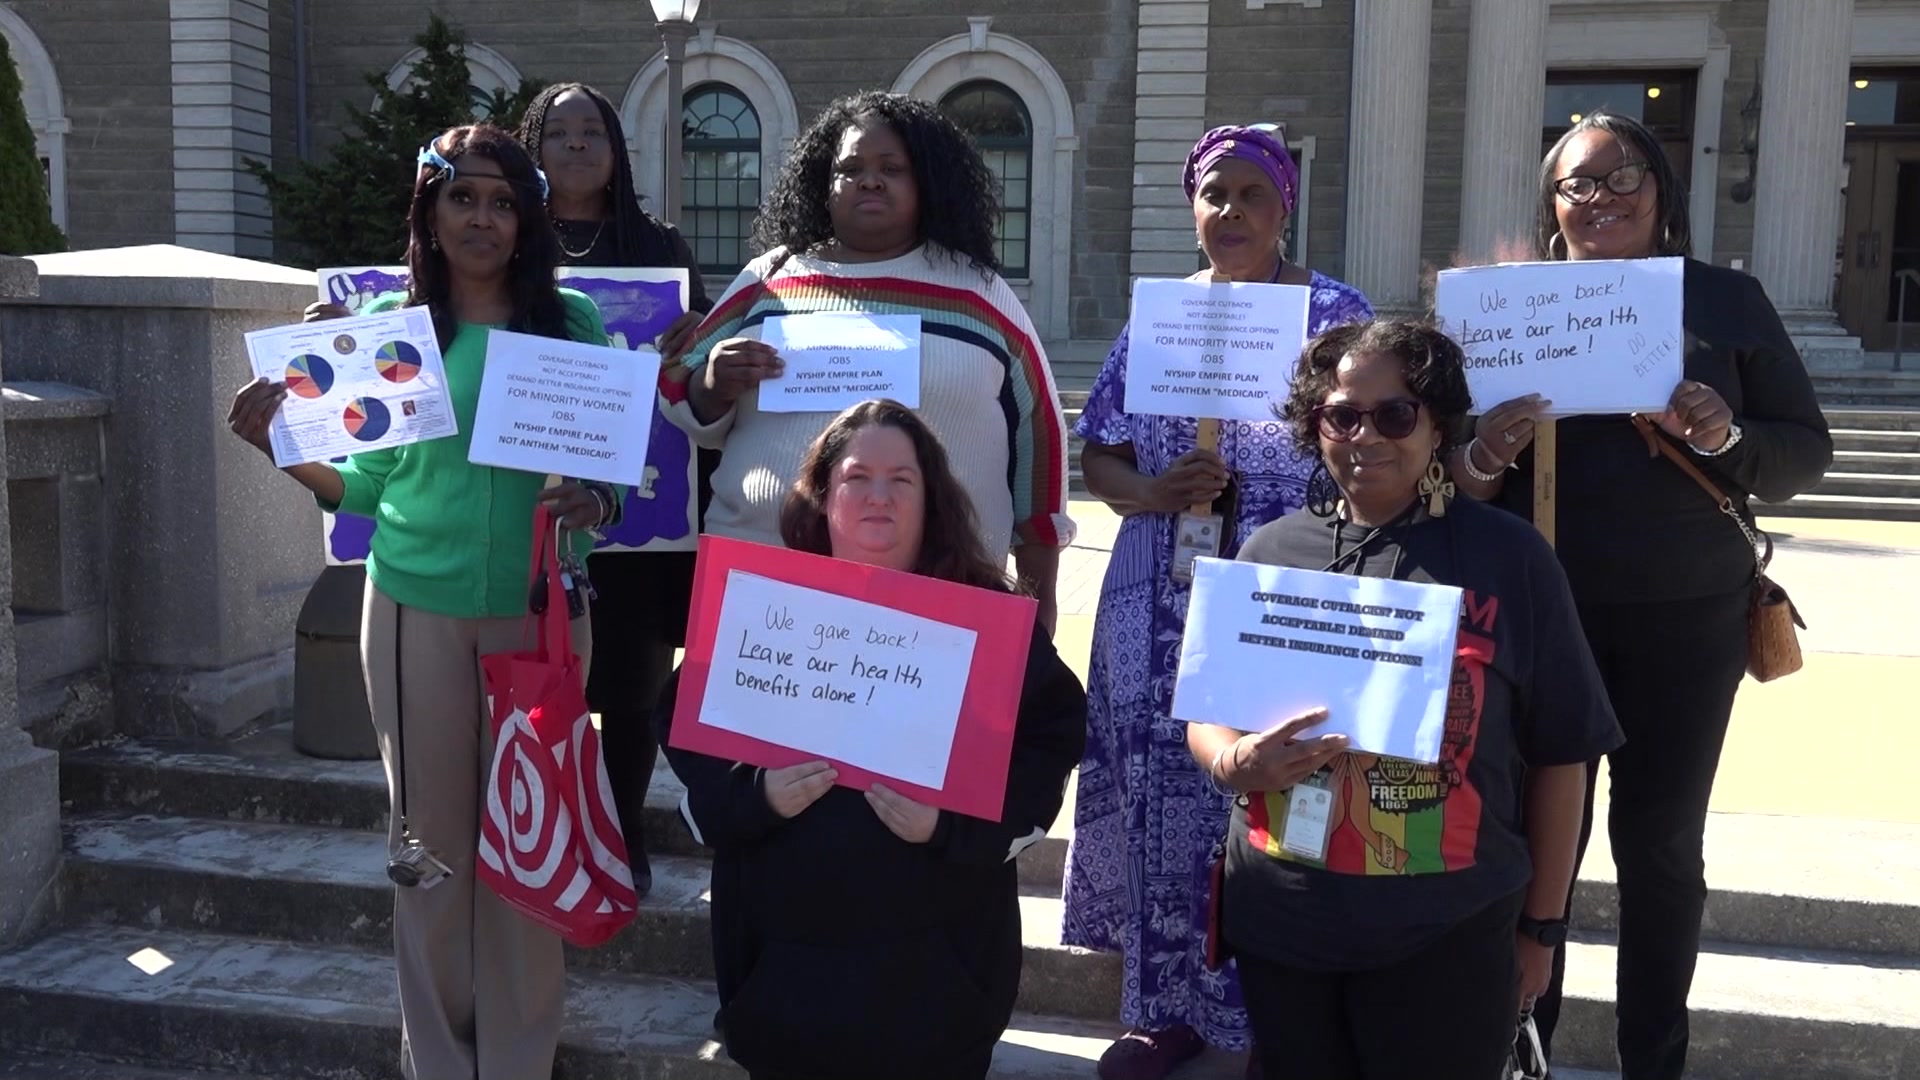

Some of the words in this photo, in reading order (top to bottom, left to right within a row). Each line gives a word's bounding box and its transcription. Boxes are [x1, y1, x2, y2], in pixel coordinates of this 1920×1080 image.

[1181, 299, 1216, 307] COVERAGE
[1218, 300, 1253, 308] CUTBACKS
[1480, 288, 1507, 314] We
[1523, 292, 1560, 320] gave
[1575, 275, 1625, 300] back!
[1152, 322, 1182, 330] DEMAND
[1209, 325, 1248, 333] INSURANCE
[1249, 327, 1280, 335] OPTIONS
[1462, 319, 1514, 345] Leave
[1526, 325, 1554, 338] our
[1567, 306, 1638, 333] health
[1155, 336, 1175, 345] FOR
[1178, 337, 1228, 349] MINORITY
[1230, 340, 1274, 351] WOMEN
[538, 354, 573, 365] COVERAGE
[574, 360, 609, 371] CUTBACKS
[828, 356, 852, 365] JOBS
[1200, 354, 1224, 365] JOBS
[542, 367, 557, 375] NOT
[796, 372, 825, 380] NYSHIP
[828, 371, 859, 379] EMPIRE
[861, 370, 883, 378] PLAN
[1164, 370, 1196, 379] NYSHIP
[1199, 372, 1232, 381] EMPIRE
[1235, 374, 1259, 382] PLAN
[506, 374, 536, 384] DEMAND
[538, 379, 562, 388] BETTER
[563, 382, 600, 393] INSURANCE
[602, 388, 632, 398] OPTIONS
[1151, 384, 1170, 393] NOT
[1171, 386, 1211, 396] ANTHEM
[508, 387, 528, 398] FOR
[530, 390, 580, 406] MINORITY
[583, 399, 625, 412] WOMEN
[552, 410, 576, 422] JOBS
[514, 422, 547, 434] NYSHIP
[548, 427, 582, 439] EMPIRE
[584, 432, 608, 443] PLAN
[498, 435, 517, 445] NOT
[519, 438, 559, 452] ANTHEM
[1251, 591, 1319, 609] COVERAGE
[1321, 600, 1393, 617] CUTBACKS?
[1394, 608, 1425, 622] NOT
[765, 604, 794, 631] We
[807, 623, 851, 651] gave
[866, 626, 919, 651] back!
[1261, 614, 1346, 634] ACCEPTABLE!
[1348, 625, 1405, 641] DEMAND
[1238, 632, 1287, 648] BETTER
[1288, 639, 1360, 659] INSURANCE
[738, 630, 793, 667] Leave
[807, 656, 839, 672] our
[851, 654, 923, 689] health
[735, 669, 800, 699] benefits
[1388, 769, 1409, 779] TEXAS
[1414, 770, 1441, 783] JUNE
[1371, 784, 1437, 800] FREEDOM
[1380, 800, 1409, 809] 1865
